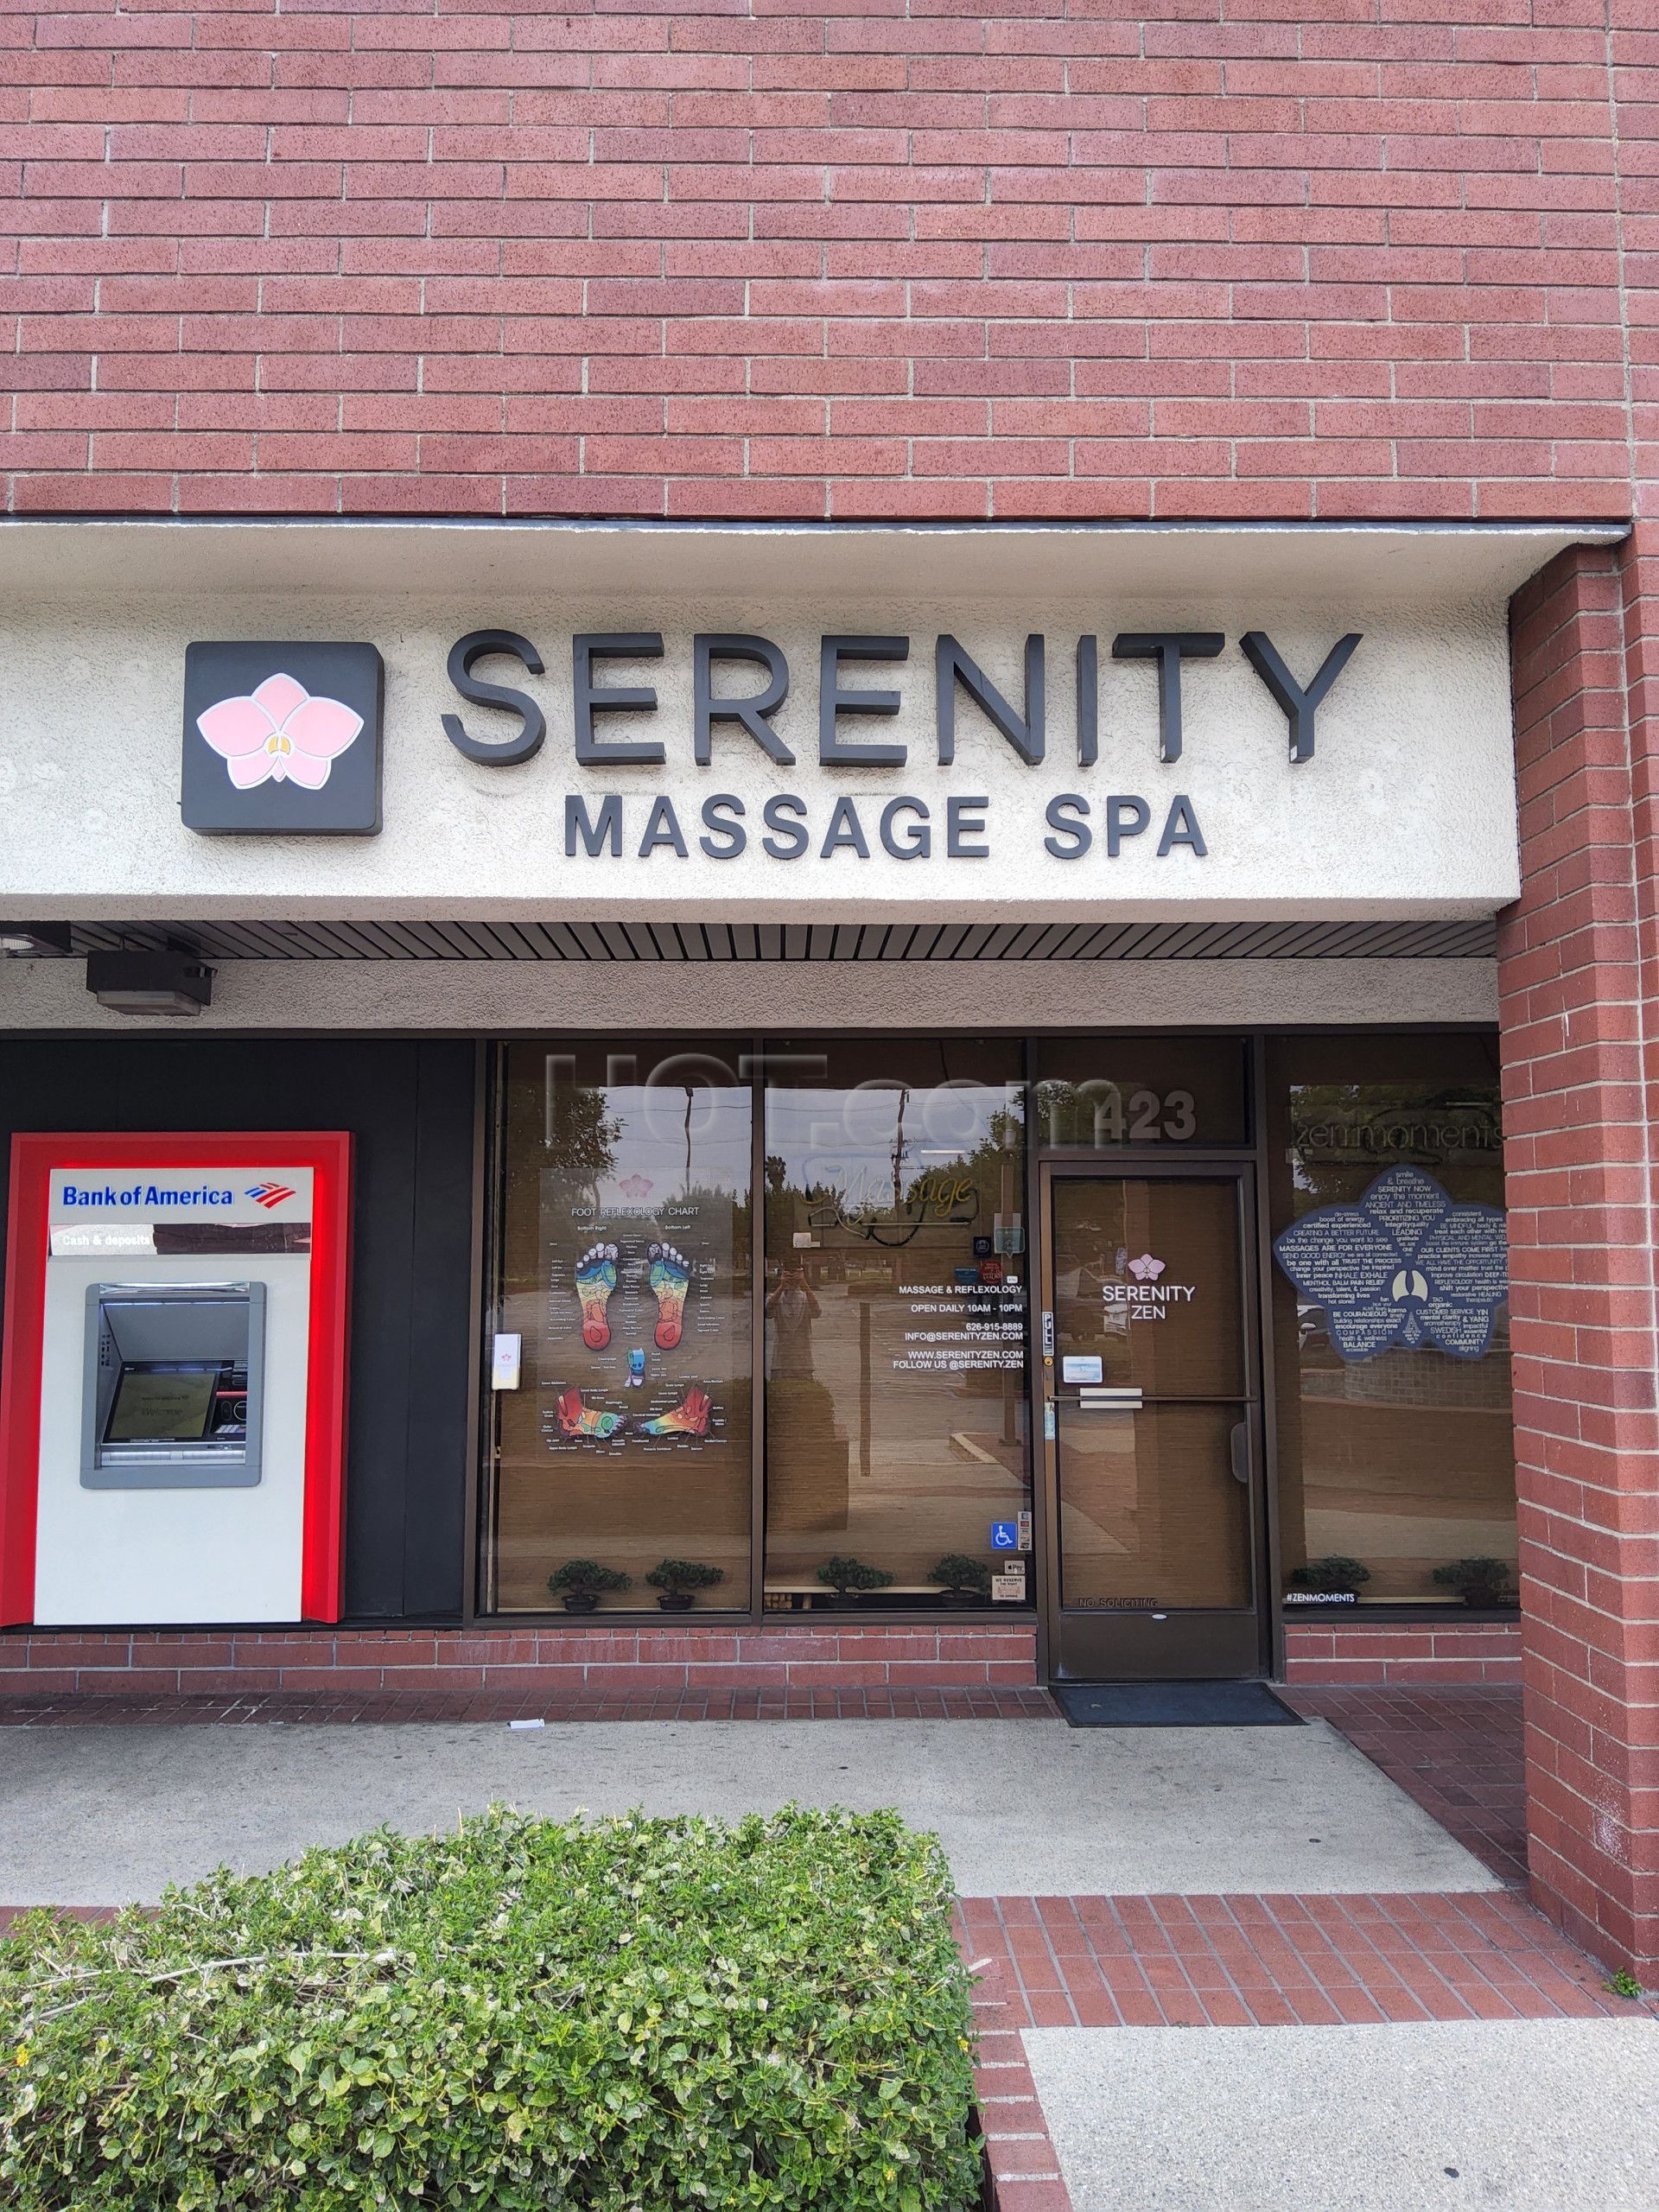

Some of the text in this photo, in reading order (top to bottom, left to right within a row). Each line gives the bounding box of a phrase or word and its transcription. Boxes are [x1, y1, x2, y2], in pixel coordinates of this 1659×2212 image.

[441, 627, 1363, 767] SERENITY
[564, 794, 1209, 861] MASSAGE SPA
[1094, 1090, 1197, 1141] 423
[63, 1185, 233, 1206] Bank of America
[571, 1206, 700, 1217] FOOT REFLEXOLOGY CHART
[63, 1235, 150, 1247] Cash & deposits
[899, 1285, 1022, 1294] MASSAGE & REFLEXOLOGY
[1103, 1286, 1196, 1301] SERENITY
[911, 1304, 938, 1313] OPEN
[939, 1304, 965, 1313] DAILY
[967, 1304, 991, 1313] 10AM
[999, 1304, 1023, 1313] 10PM
[1131, 1305, 1166, 1319] ZEN
[905, 1332, 1023, 1342] INFO@SERENITYZEN.COM
[908, 1351, 1024, 1360] WWW.SERENITYZEN.COM
[893, 1360, 1024, 1370] FOLLOW US @SERENITY.ZEN
[1079, 1598, 1158, 1607] NO SOLICITING
[1286, 1592, 1355, 1603] #ZENMOMENTS
